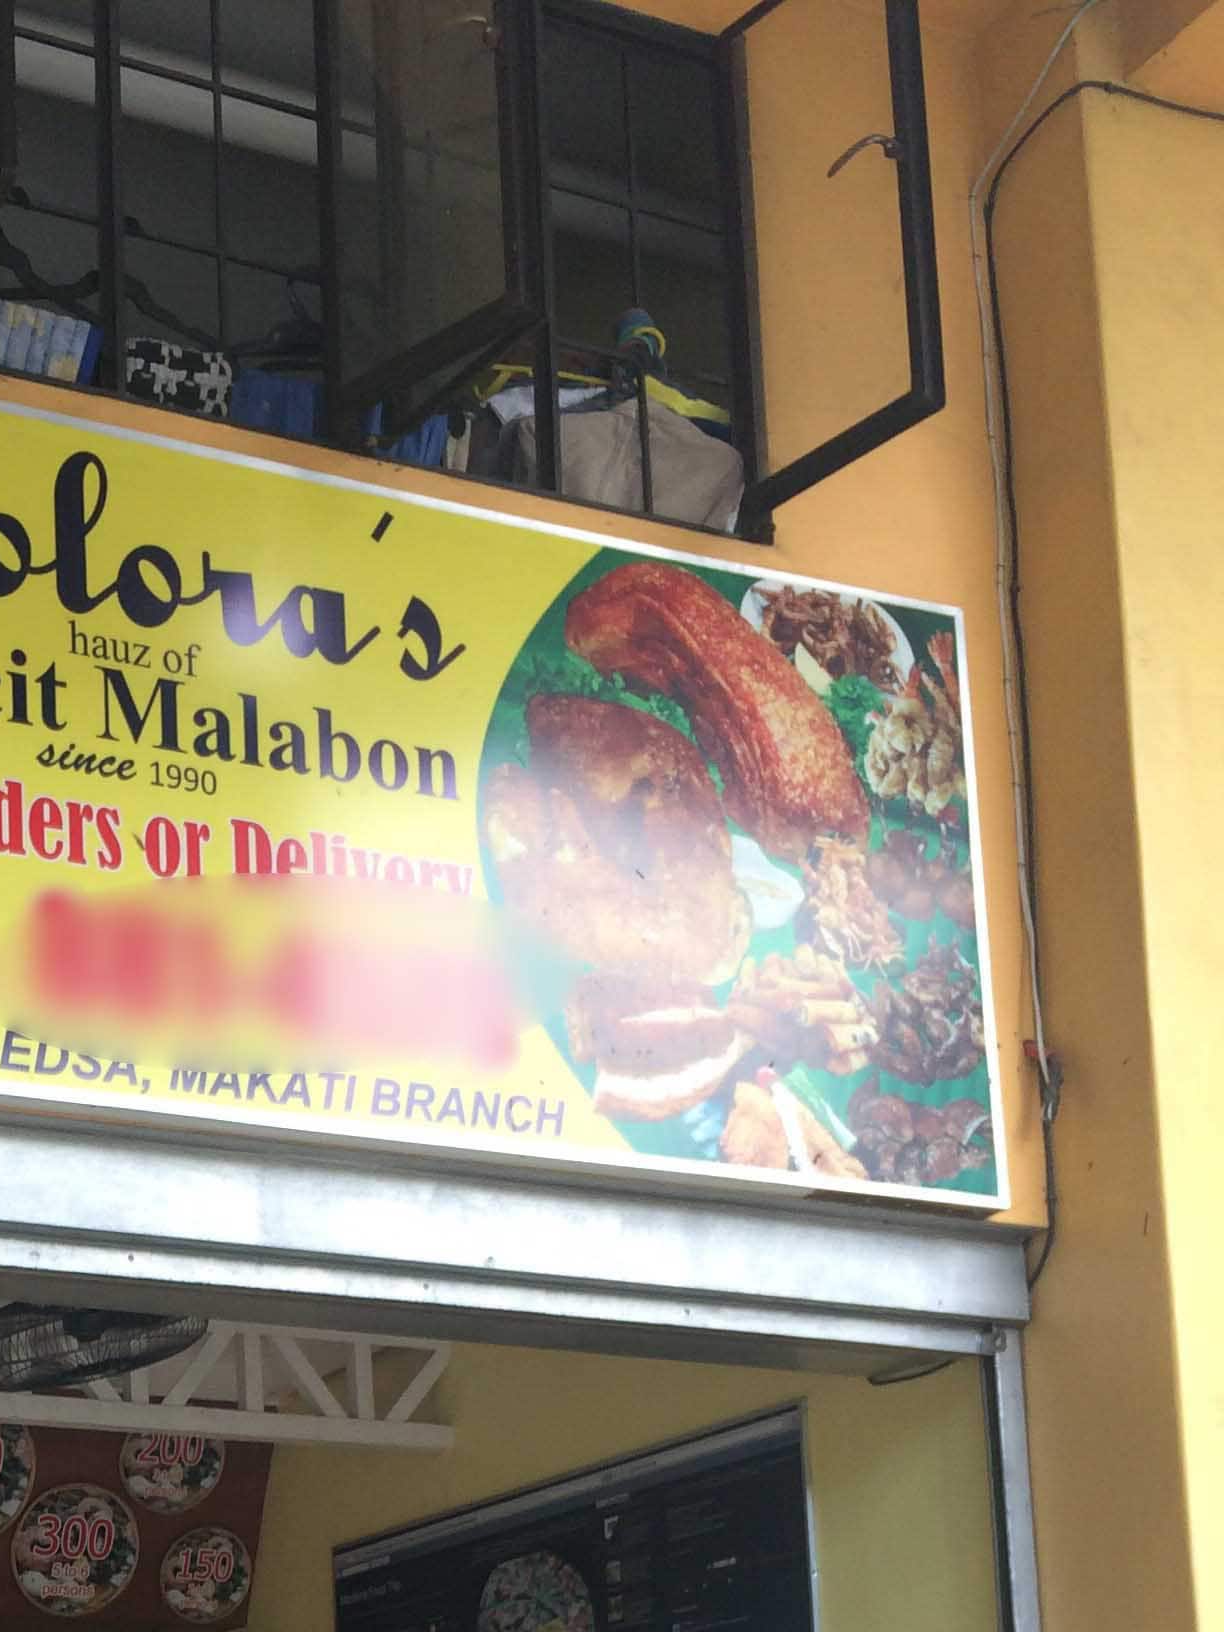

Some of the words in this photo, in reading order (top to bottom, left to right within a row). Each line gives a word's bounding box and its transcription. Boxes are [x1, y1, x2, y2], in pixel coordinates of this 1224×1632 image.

[67, 620, 152, 669] hauz
[162, 644, 202, 677] of
[94, 665, 460, 801] Malabon
[36, 743, 137, 781] since
[150, 761, 217, 796] 1990
[144, 816, 210, 878] or
[370, 1078, 566, 1137] BRANCH
[137, 1432, 204, 1466] 200
[31, 1514, 116, 1561] 300
[176, 1549, 233, 1584] 150
